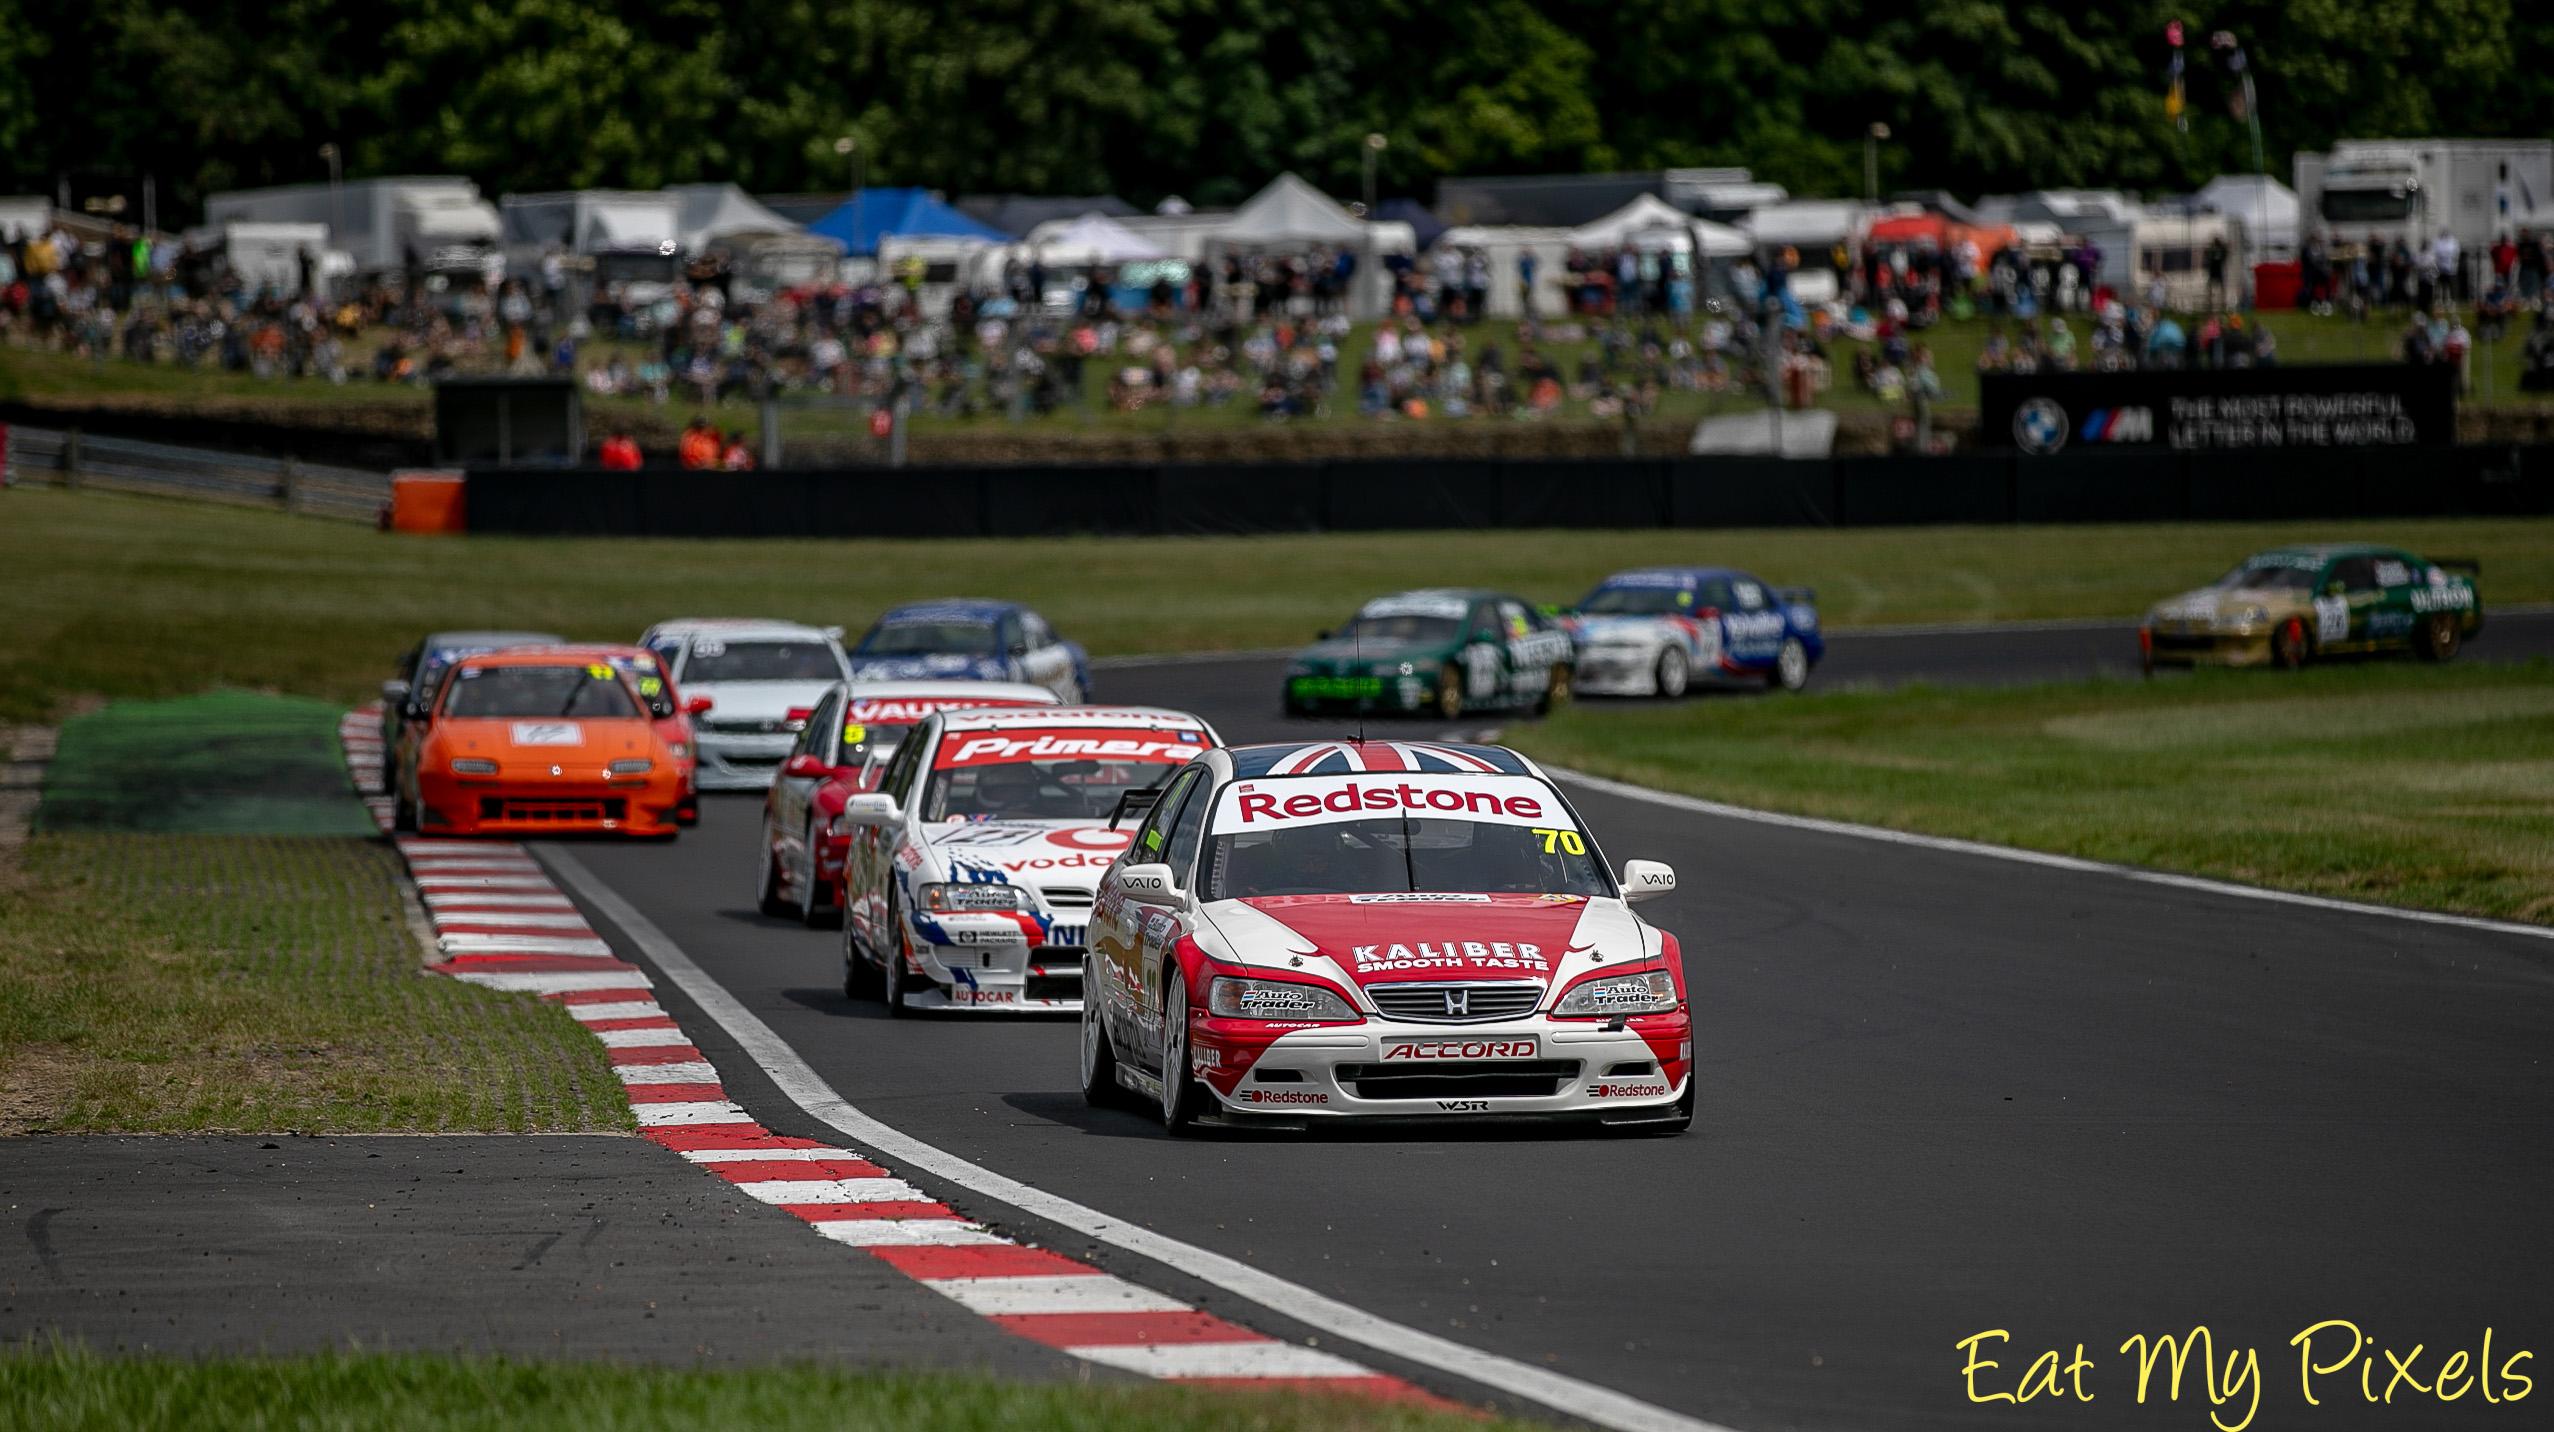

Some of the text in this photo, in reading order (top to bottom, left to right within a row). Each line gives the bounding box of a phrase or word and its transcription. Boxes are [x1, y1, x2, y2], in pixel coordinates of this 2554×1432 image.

[952, 736, 1203, 762] Primera
[1238, 783, 1543, 824] Redstone
[1532, 829, 1586, 856] 70
[1123, 878, 1162, 889] VAIO
[1641, 874, 1674, 885] VAIO
[1352, 942, 1547, 963] KALIBER
[1357, 958, 1550, 974] SMOOTH TASTE
[1253, 990, 1303, 1000] Auto
[1606, 986, 1648, 995] Auto
[955, 991, 1014, 1003] AUTOCAR
[1594, 993, 1660, 1005] Trader
[1240, 999, 1315, 1011] Trader
[1383, 1041, 1536, 1060] ACCORD
[1609, 1084, 1665, 1097] Redstone
[1264, 1090, 1329, 1104] Redstone
[1436, 1101, 1489, 1111] WSR
